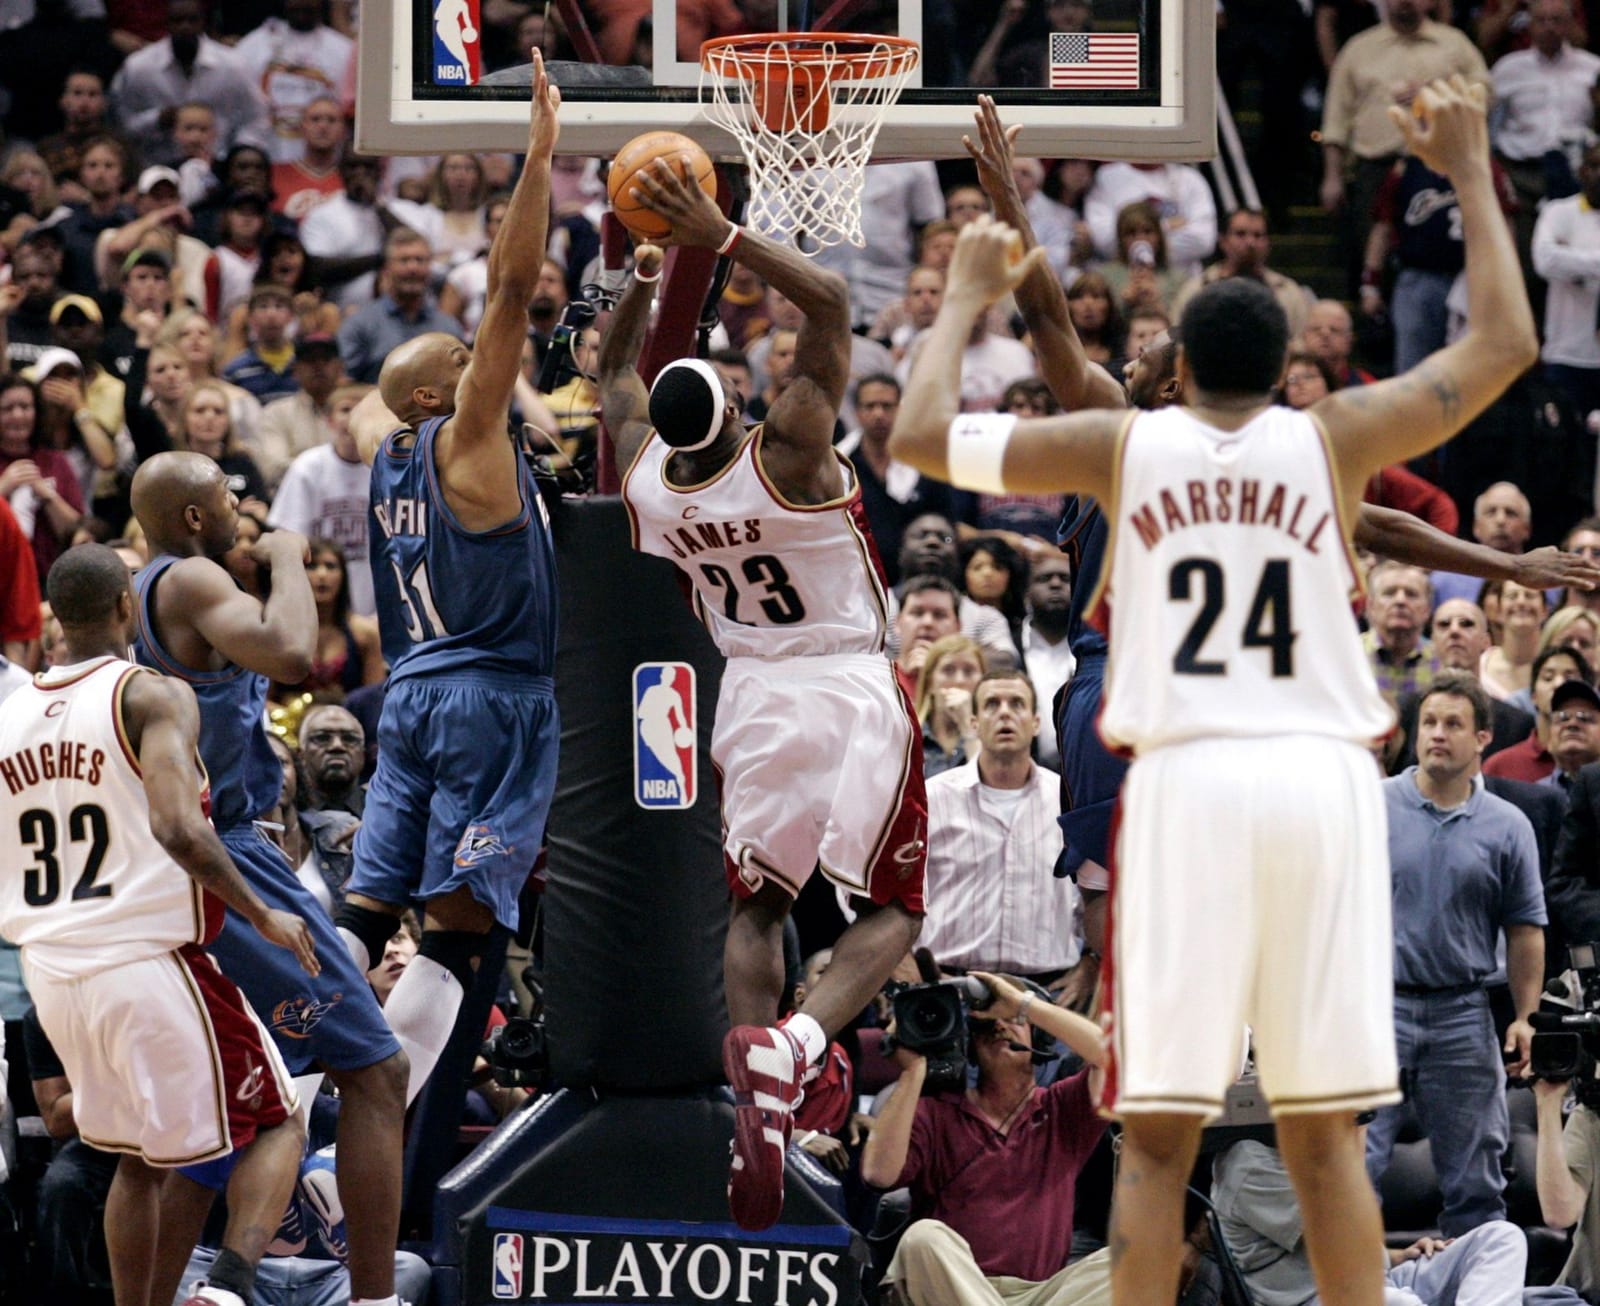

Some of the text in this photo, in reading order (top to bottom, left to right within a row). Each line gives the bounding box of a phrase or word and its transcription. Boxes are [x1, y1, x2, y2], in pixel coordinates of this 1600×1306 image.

[438, 65, 464, 79] NBA
[663, 519, 761, 559] JAMES
[1131, 478, 1329, 554] MARSHALL
[700, 555, 806, 627] 23
[1168, 557, 1299, 678] 24
[0, 741, 105, 796] HUGHES
[643, 780, 678, 799] NBA
[19, 803, 113, 907] 32
[530, 1236, 840, 1306] PLAYOFFS
